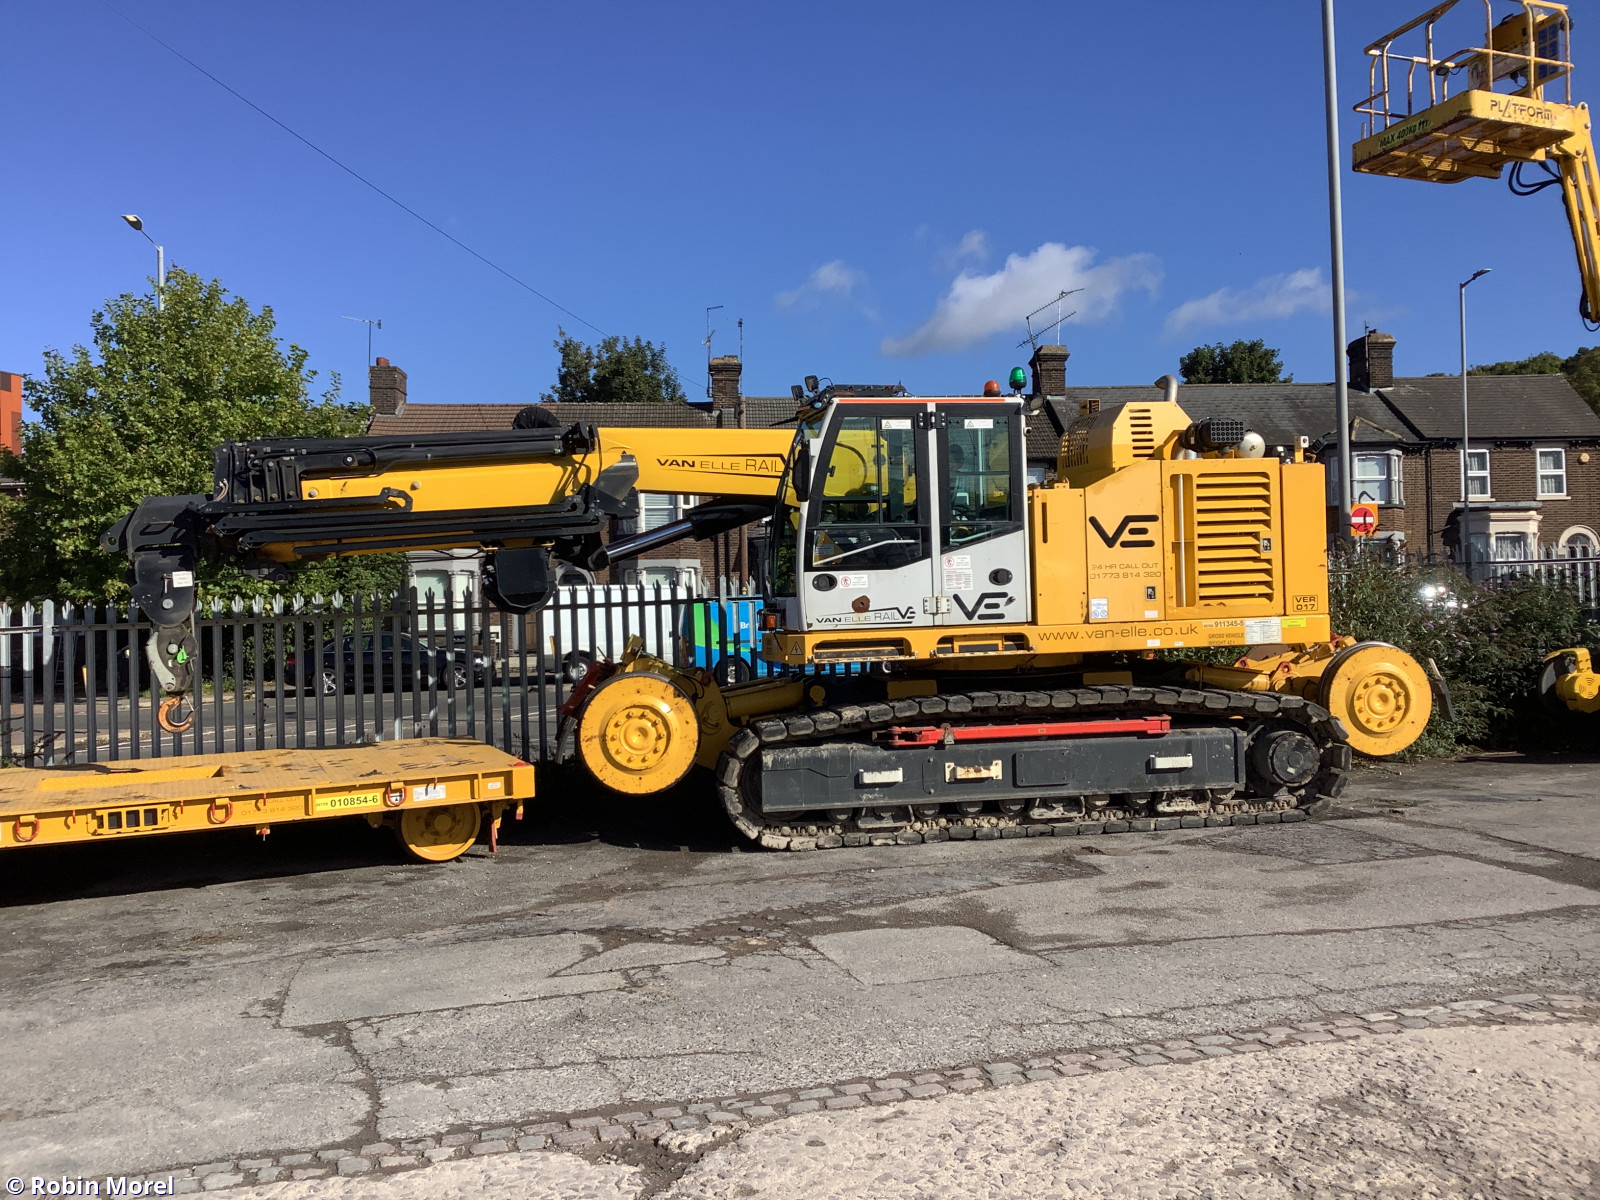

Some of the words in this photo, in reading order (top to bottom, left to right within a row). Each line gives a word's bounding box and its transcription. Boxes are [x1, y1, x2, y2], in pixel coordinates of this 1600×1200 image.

[1379, 133, 1396, 148] MAX
[656, 458, 695, 468] VAN
[700, 460, 740, 471] ELLE
[745, 458, 784, 473] RAIL
[1088, 514, 1160, 548] VE
[1118, 562, 1140, 570] CALL
[1089, 572, 1120, 580] 01773
[1122, 571, 1141, 579] 814
[844, 615, 871, 623] ELLE
[873, 611, 899, 621] RAIL
[1214, 620, 1245, 628] 911345-5
[1037, 624, 1199, 641] www.van-elle.co.uk
[330, 795, 379, 808] 010854-6
